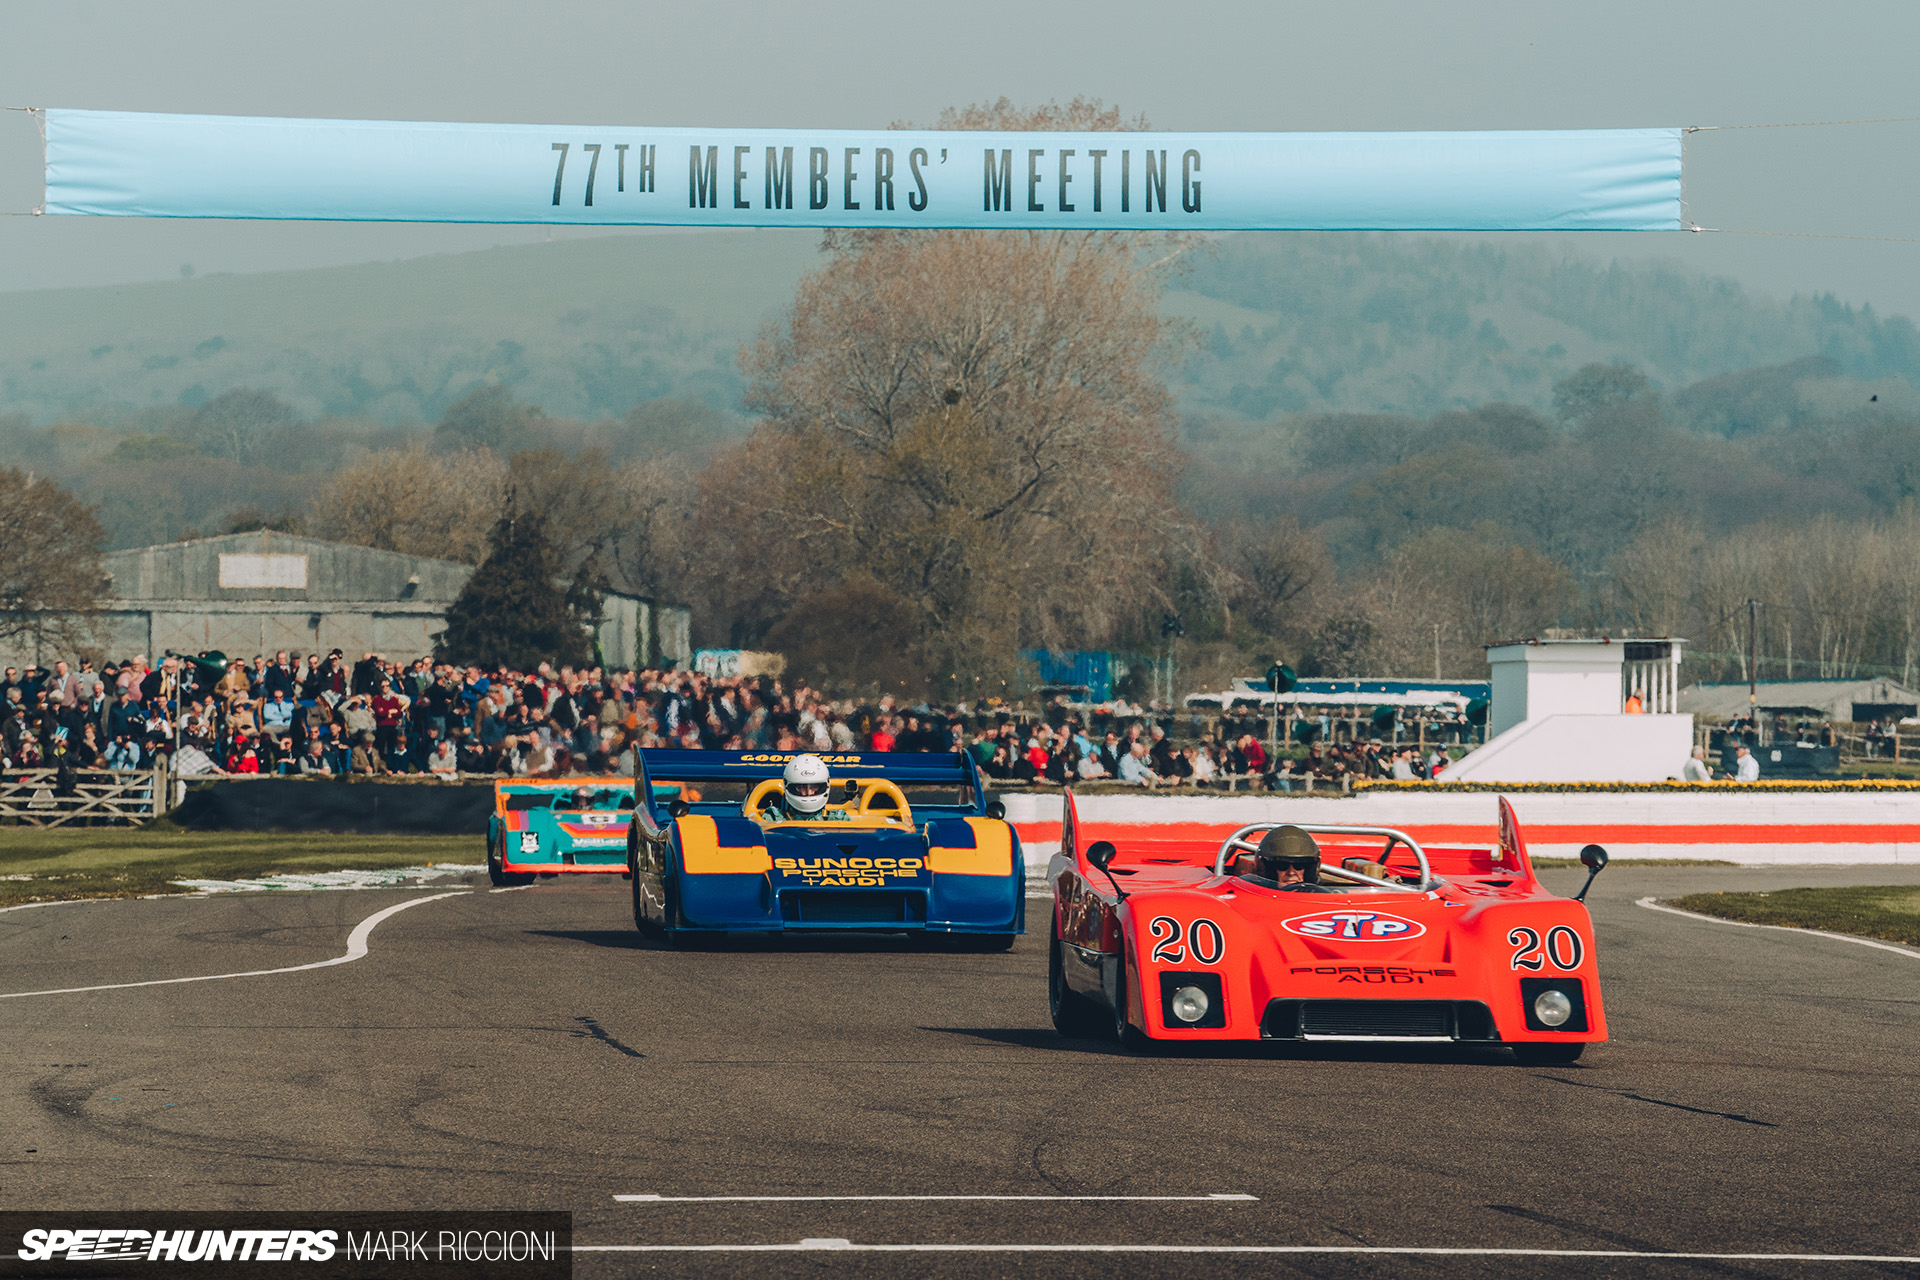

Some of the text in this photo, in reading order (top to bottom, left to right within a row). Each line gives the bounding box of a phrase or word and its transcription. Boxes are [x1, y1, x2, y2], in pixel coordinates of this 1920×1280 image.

[551, 142, 656, 207] 77TH
[983, 148, 1202, 213] MEETING
[740, 752, 862, 763] GOODEAR
[774, 857, 923, 869] SUNOCO
[782, 869, 917, 878] PORSCHE
[1299, 914, 1410, 938] STP
[1149, 915, 1226, 966] 20
[1508, 924, 1585, 972] 20
[1290, 966, 1457, 977] PORSCHE
[1338, 974, 1424, 984] AUDI
